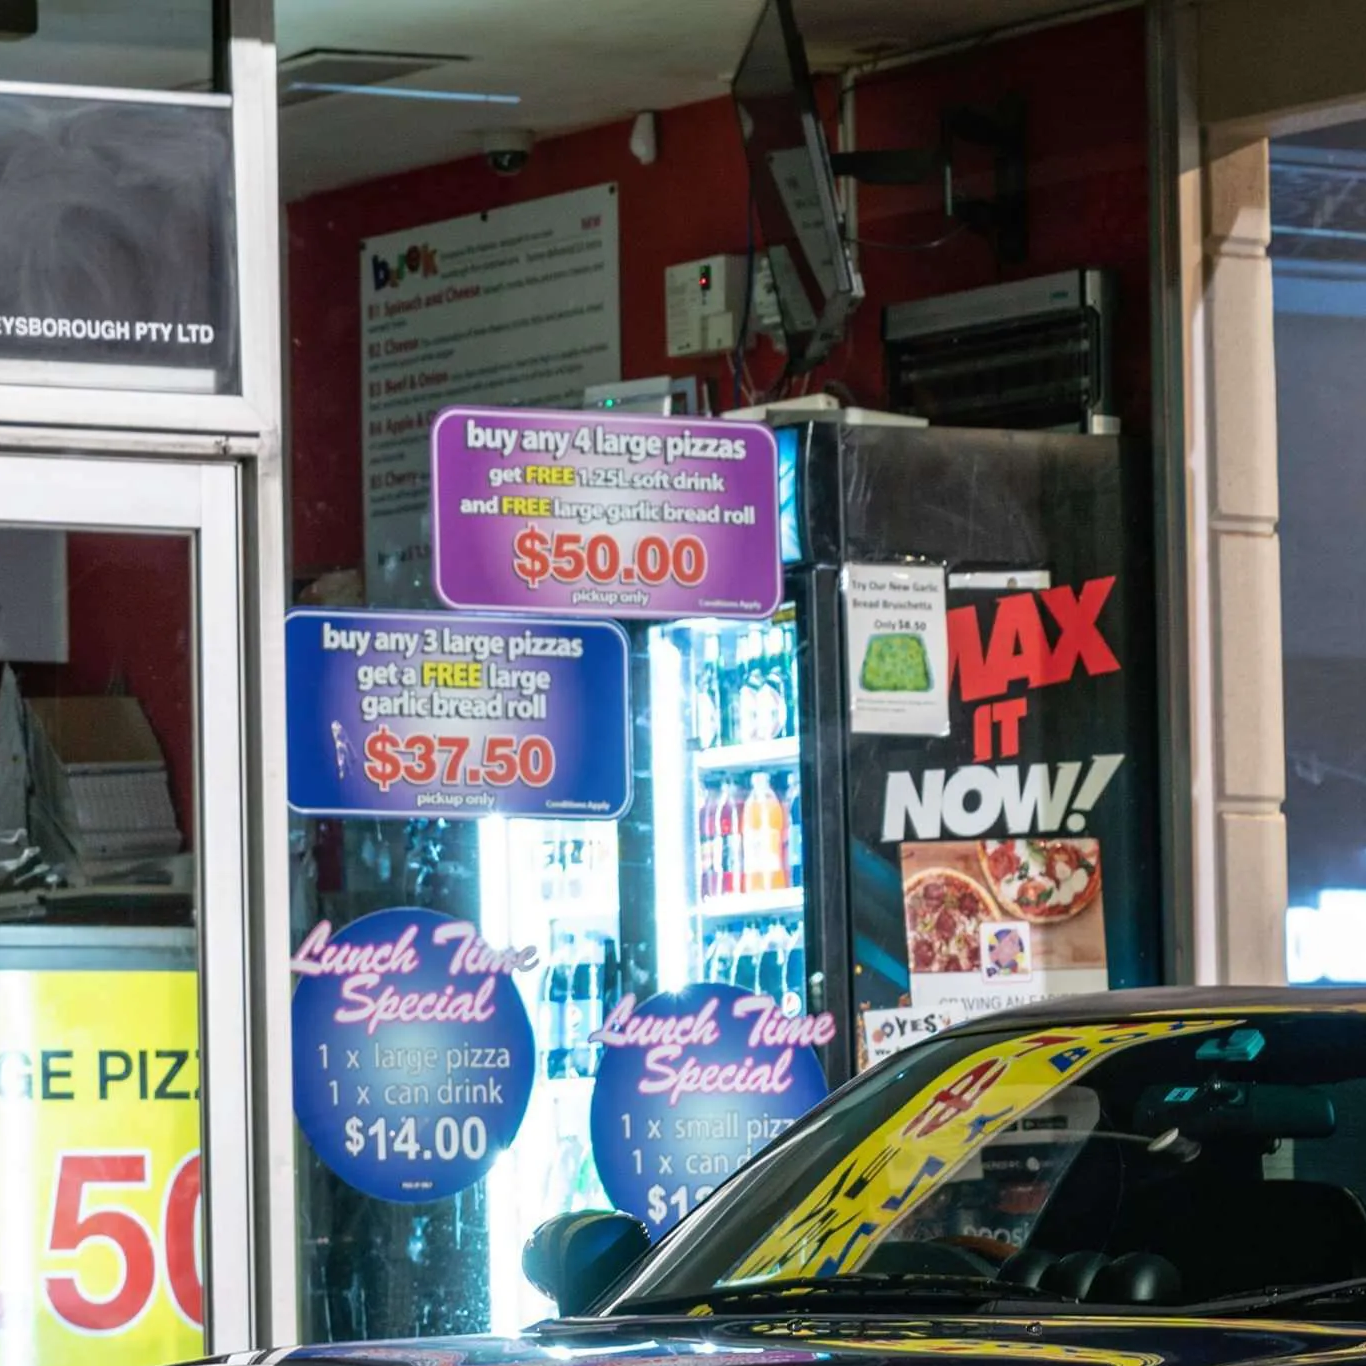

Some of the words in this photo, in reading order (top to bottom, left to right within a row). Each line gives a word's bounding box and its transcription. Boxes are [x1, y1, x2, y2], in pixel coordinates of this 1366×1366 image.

[135, 321, 175, 343] PTY
[178, 323, 215, 345] LTD
[467, 419, 517, 457] buy
[522, 426, 572, 460] any
[574, 426, 592, 452] 4
[596, 426, 661, 461] large
[666, 430, 747, 464] pizzas
[489, 466, 523, 487] get
[525, 466, 576, 486] FREE
[578, 468, 630, 489] 1.25L
[631, 468, 670, 491] soft
[673, 470, 725, 493] drink
[460, 496, 498, 514] and
[502, 496, 551, 516] FREE
[554, 499, 603, 524] large
[604, 500, 661, 525] garlic
[663, 504, 720, 524] bread
[723, 505, 755, 525] roll
[513, 523, 709, 588] $50.00
[571, 589, 618, 606] pickup
[619, 590, 650, 607] only
[852, 580, 866, 592] Try
[869, 581, 886, 591] Our
[889, 581, 910, 592] New
[912, 581, 939, 593] Garlic
[852, 598, 880, 609] Bread
[882, 599, 932, 611] Bruschetta
[874, 619, 896, 631] Only
[323, 622, 372, 656] buy
[374, 630, 420, 658] any
[423, 629, 438, 650] 3
[442, 628, 505, 661] large
[508, 631, 584, 660] pizzas
[357, 664, 398, 691] get
[401, 668, 416, 686] a
[422, 662, 482, 688] FREE
[489, 664, 551, 692] large
[361, 692, 432, 721] garlic
[433, 693, 502, 719] bread
[506, 694, 547, 720] roll
[364, 723, 556, 792] $37.50
[416, 791, 463, 808] pickup
[465, 793, 496, 810] only
[881, 753, 1126, 843] NOW!
[291, 919, 421, 976] Lunch
[431, 919, 541, 977] Time
[334, 972, 497, 1036] Special
[588, 992, 721, 1047] Lunch
[731, 995, 836, 1048] Time
[318, 1043, 329, 1069] 1
[346, 1049, 361, 1069] x
[374, 1043, 438, 1075] large
[445, 1042, 512, 1073] pizza
[98, 1049, 199, 1101] PIZ
[638, 1043, 794, 1108] Special
[329, 1080, 339, 1106] 1
[356, 1086, 371, 1105] x
[384, 1085, 430, 1105] can
[437, 1076, 504, 1105] drink
[344, 1115, 487, 1161] $14.00
[621, 1113, 631, 1140] 1
[647, 1120, 662, 1140] x
[675, 1112, 740, 1139] small
[632, 1149, 642, 1175] 1
[659, 1156, 673, 1175] x
[686, 1155, 729, 1175] can
